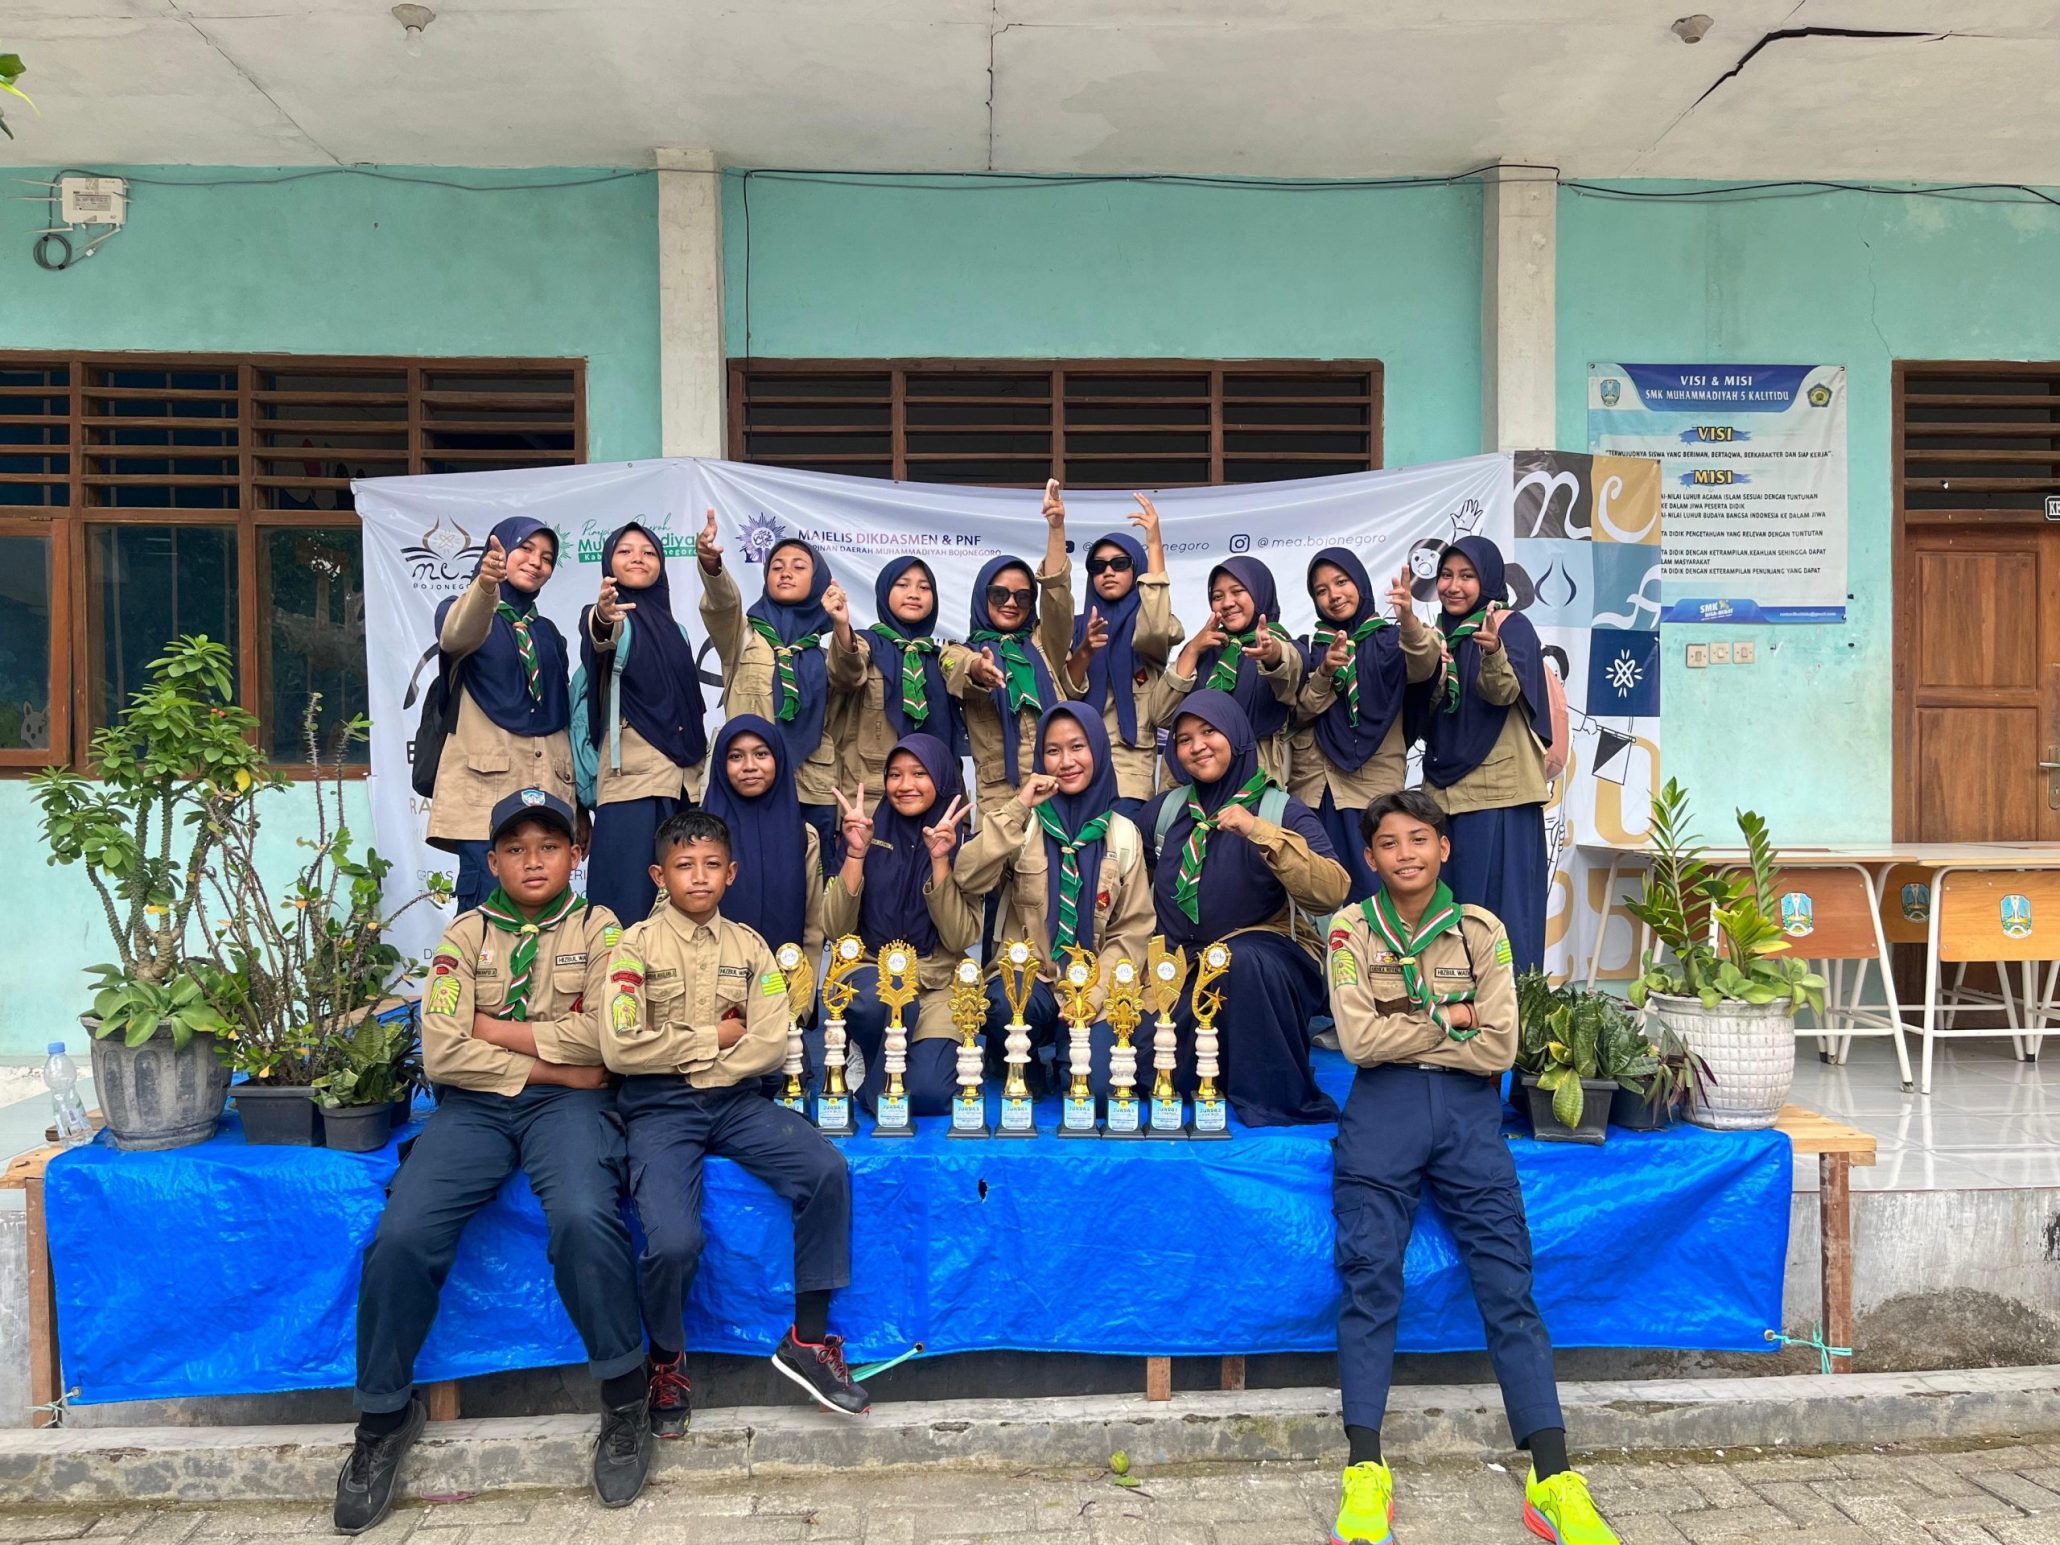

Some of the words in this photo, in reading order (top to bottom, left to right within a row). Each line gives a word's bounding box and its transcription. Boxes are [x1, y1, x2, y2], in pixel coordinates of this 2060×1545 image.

[1680, 376, 1706, 386] VISI
[1711, 376, 1719, 386] &
[1724, 376, 1752, 386] MISI
[1645, 389, 1663, 400] SMK
[1666, 390, 1738, 400] MUHAMMADIYAH
[1741, 391, 1746, 400] 5
[1749, 391, 1789, 401] KALITIDU
[1696, 427, 1733, 441] VISI
[1693, 470, 1733, 485] MISI
[798, 530, 852, 542] MAJELIS
[856, 533, 938, 545] DIKDASMEN
[942, 534, 952, 545] &
[956, 534, 981, 546] PNF
[840, 546, 873, 554] DAERAH
[875, 547, 947, 556] MUHAMMADIYAH
[948, 549, 1002, 557] BOJONEGORO
[1700, 602, 1718, 613] SMK
